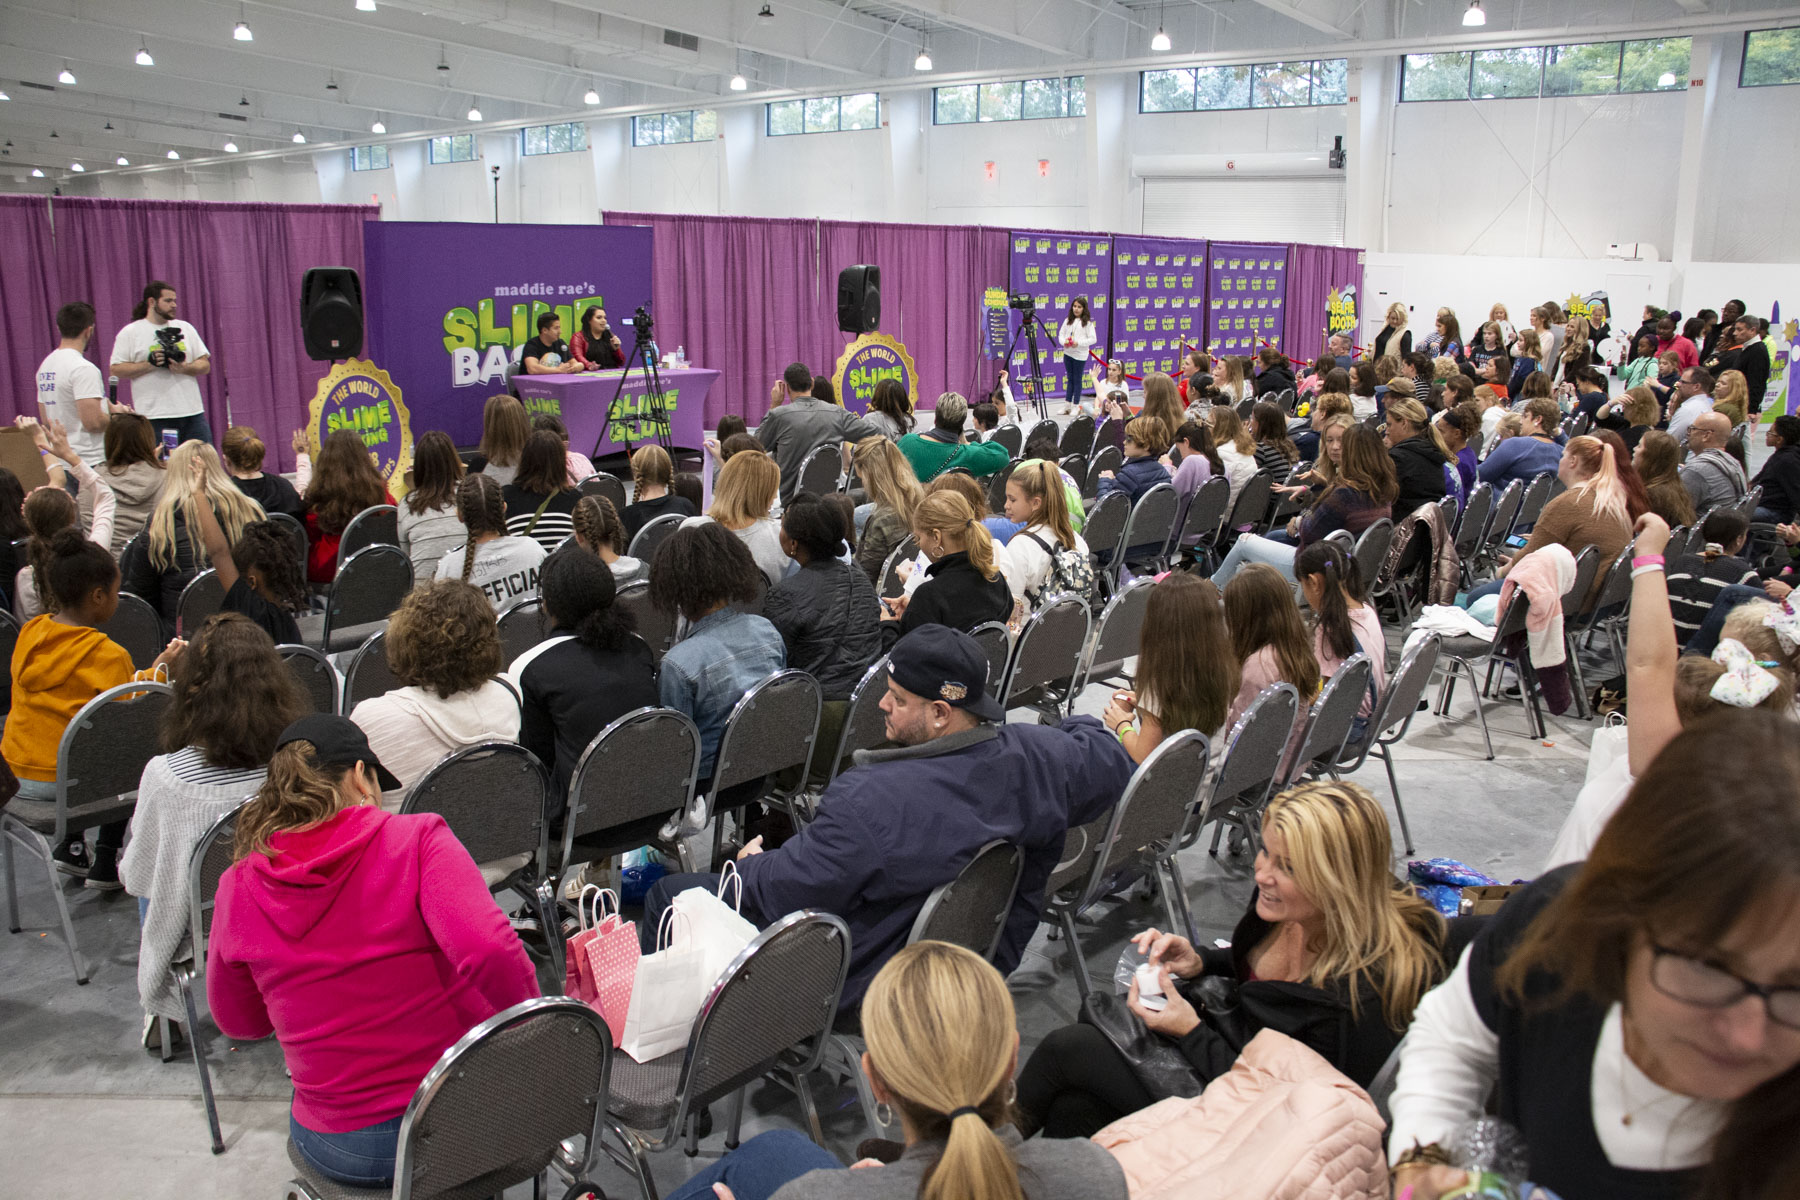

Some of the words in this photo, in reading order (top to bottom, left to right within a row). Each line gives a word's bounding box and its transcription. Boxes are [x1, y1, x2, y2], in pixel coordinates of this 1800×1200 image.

[1227, 162, 1234, 170] G
[494, 282, 554, 296] maddie
[558, 282, 596, 295] rae's
[1331, 301, 1355, 316] SELFIE
[1330, 316, 1356, 332] BOOTH
[856, 350, 870, 364] THE
[870, 348, 896, 364] WORLD
[849, 366, 903, 390] SLIME
[332, 386, 349, 405] THE
[348, 380, 379, 398] WORLD
[327, 400, 392, 434] SLIME
[481, 566, 542, 602] FFICIA
